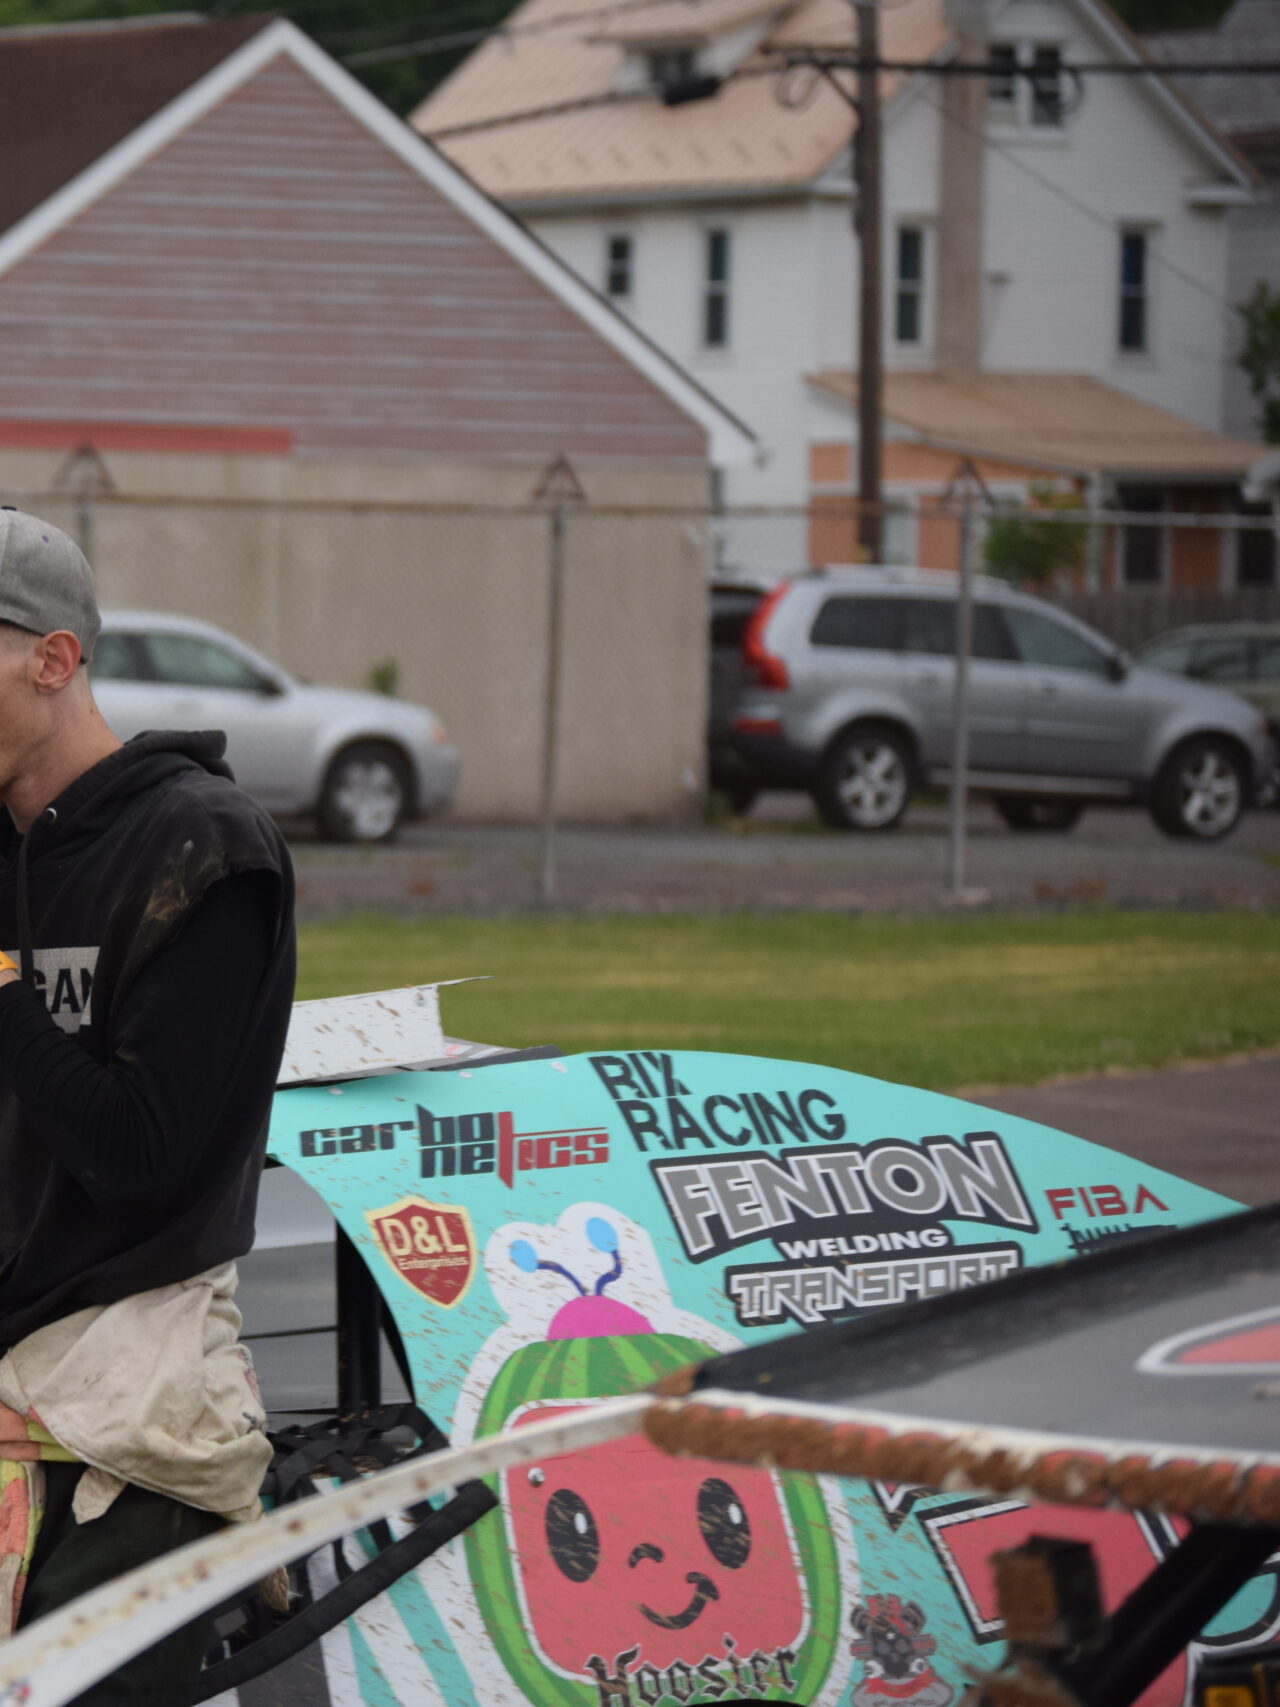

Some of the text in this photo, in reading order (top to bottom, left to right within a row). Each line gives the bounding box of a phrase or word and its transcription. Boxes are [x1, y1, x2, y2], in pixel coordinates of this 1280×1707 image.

[587, 1052, 692, 1101] RIX
[616, 1088, 848, 1153] RACING
[655, 1138, 1035, 1257] FENTON
[380, 1215, 468, 1256] D&L
[779, 1228, 950, 1260] WELDING
[730, 1248, 1019, 1323] TRANSPORT
[584, 1632, 797, 1707] Hoosier
